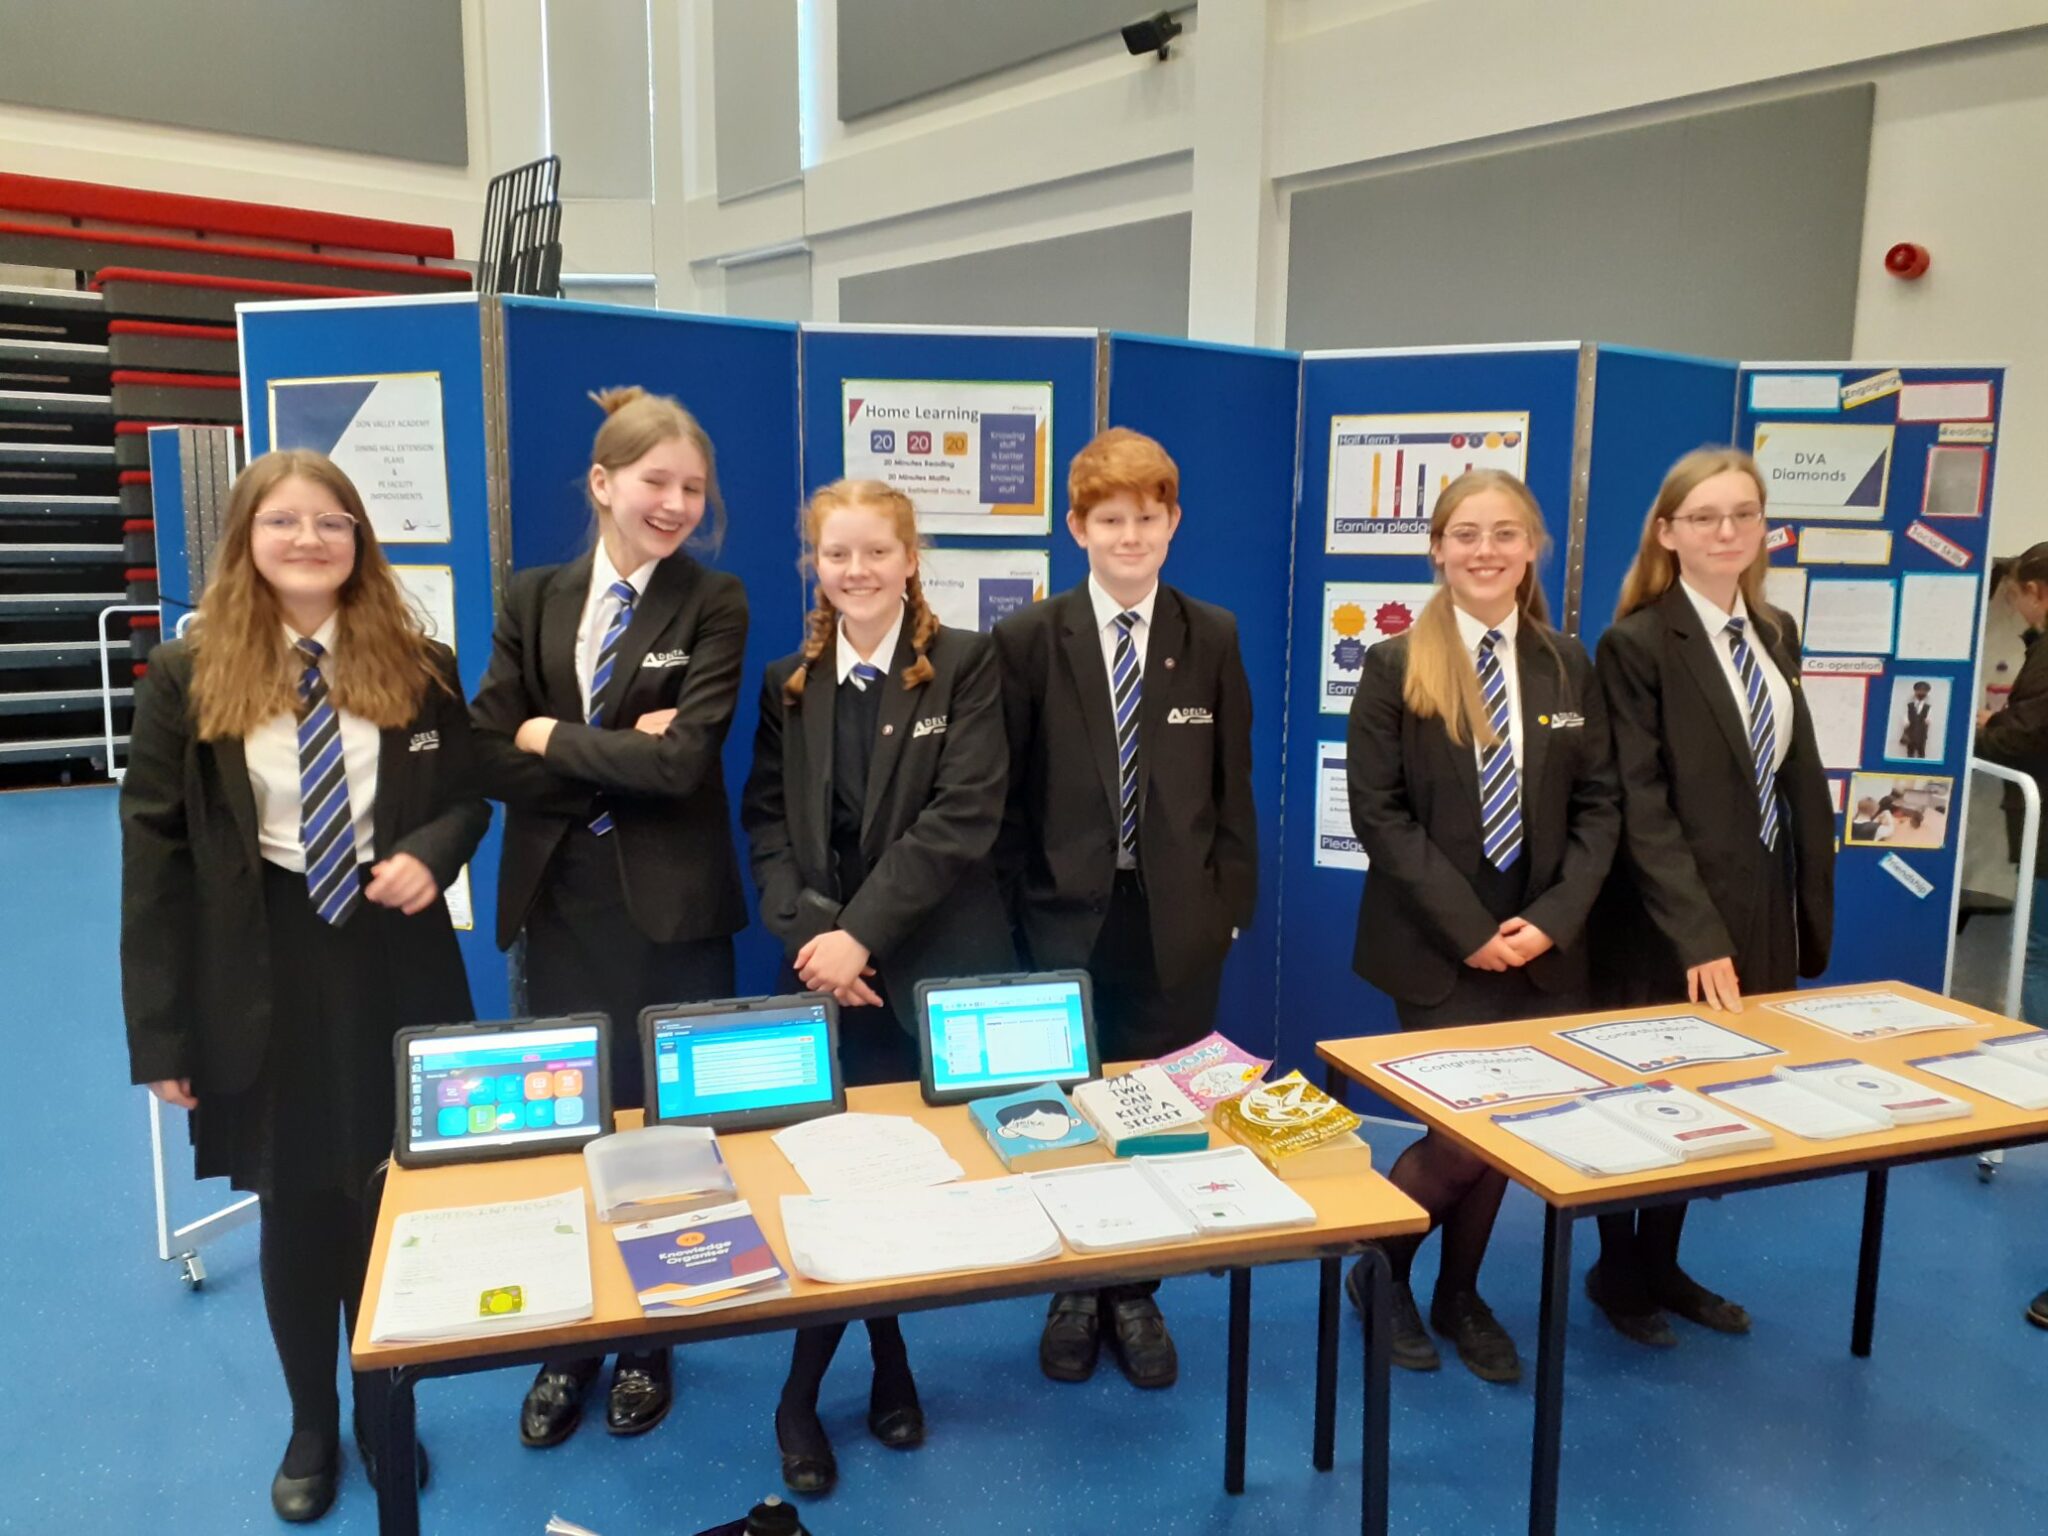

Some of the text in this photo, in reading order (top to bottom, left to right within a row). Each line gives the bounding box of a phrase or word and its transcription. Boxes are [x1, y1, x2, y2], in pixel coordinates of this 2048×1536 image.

[865, 405, 979, 423] Home Learning
[398, 419, 430, 427] ACADEMY
[873, 434, 893, 450] 20
[909, 435, 929, 451] 20
[946, 436, 965, 452] 20
[991, 431, 1025, 442] Knowing
[1339, 436, 1361, 445] Half
[1364, 435, 1392, 445] Term
[397, 444, 434, 452] EXTENSION
[924, 460, 955, 469] Reading
[1794, 453, 1827, 466] DVA
[1772, 468, 1847, 483] Diamonds
[1336, 519, 1431, 534] Earning pledg
[1808, 659, 1881, 671] Co-operation
[1328, 683, 1359, 695] Earn
[1419, 1056, 1533, 1073] Congratulations
[1111, 1083, 1147, 1097] TWO
[1120, 1094, 1152, 1106] CAN
[1115, 1101, 1175, 1119] KEEP A
[1123, 1109, 1183, 1130] SECRET
[659, 1241, 732, 1260] Knowledge
[666, 1248, 729, 1265] Organiser
